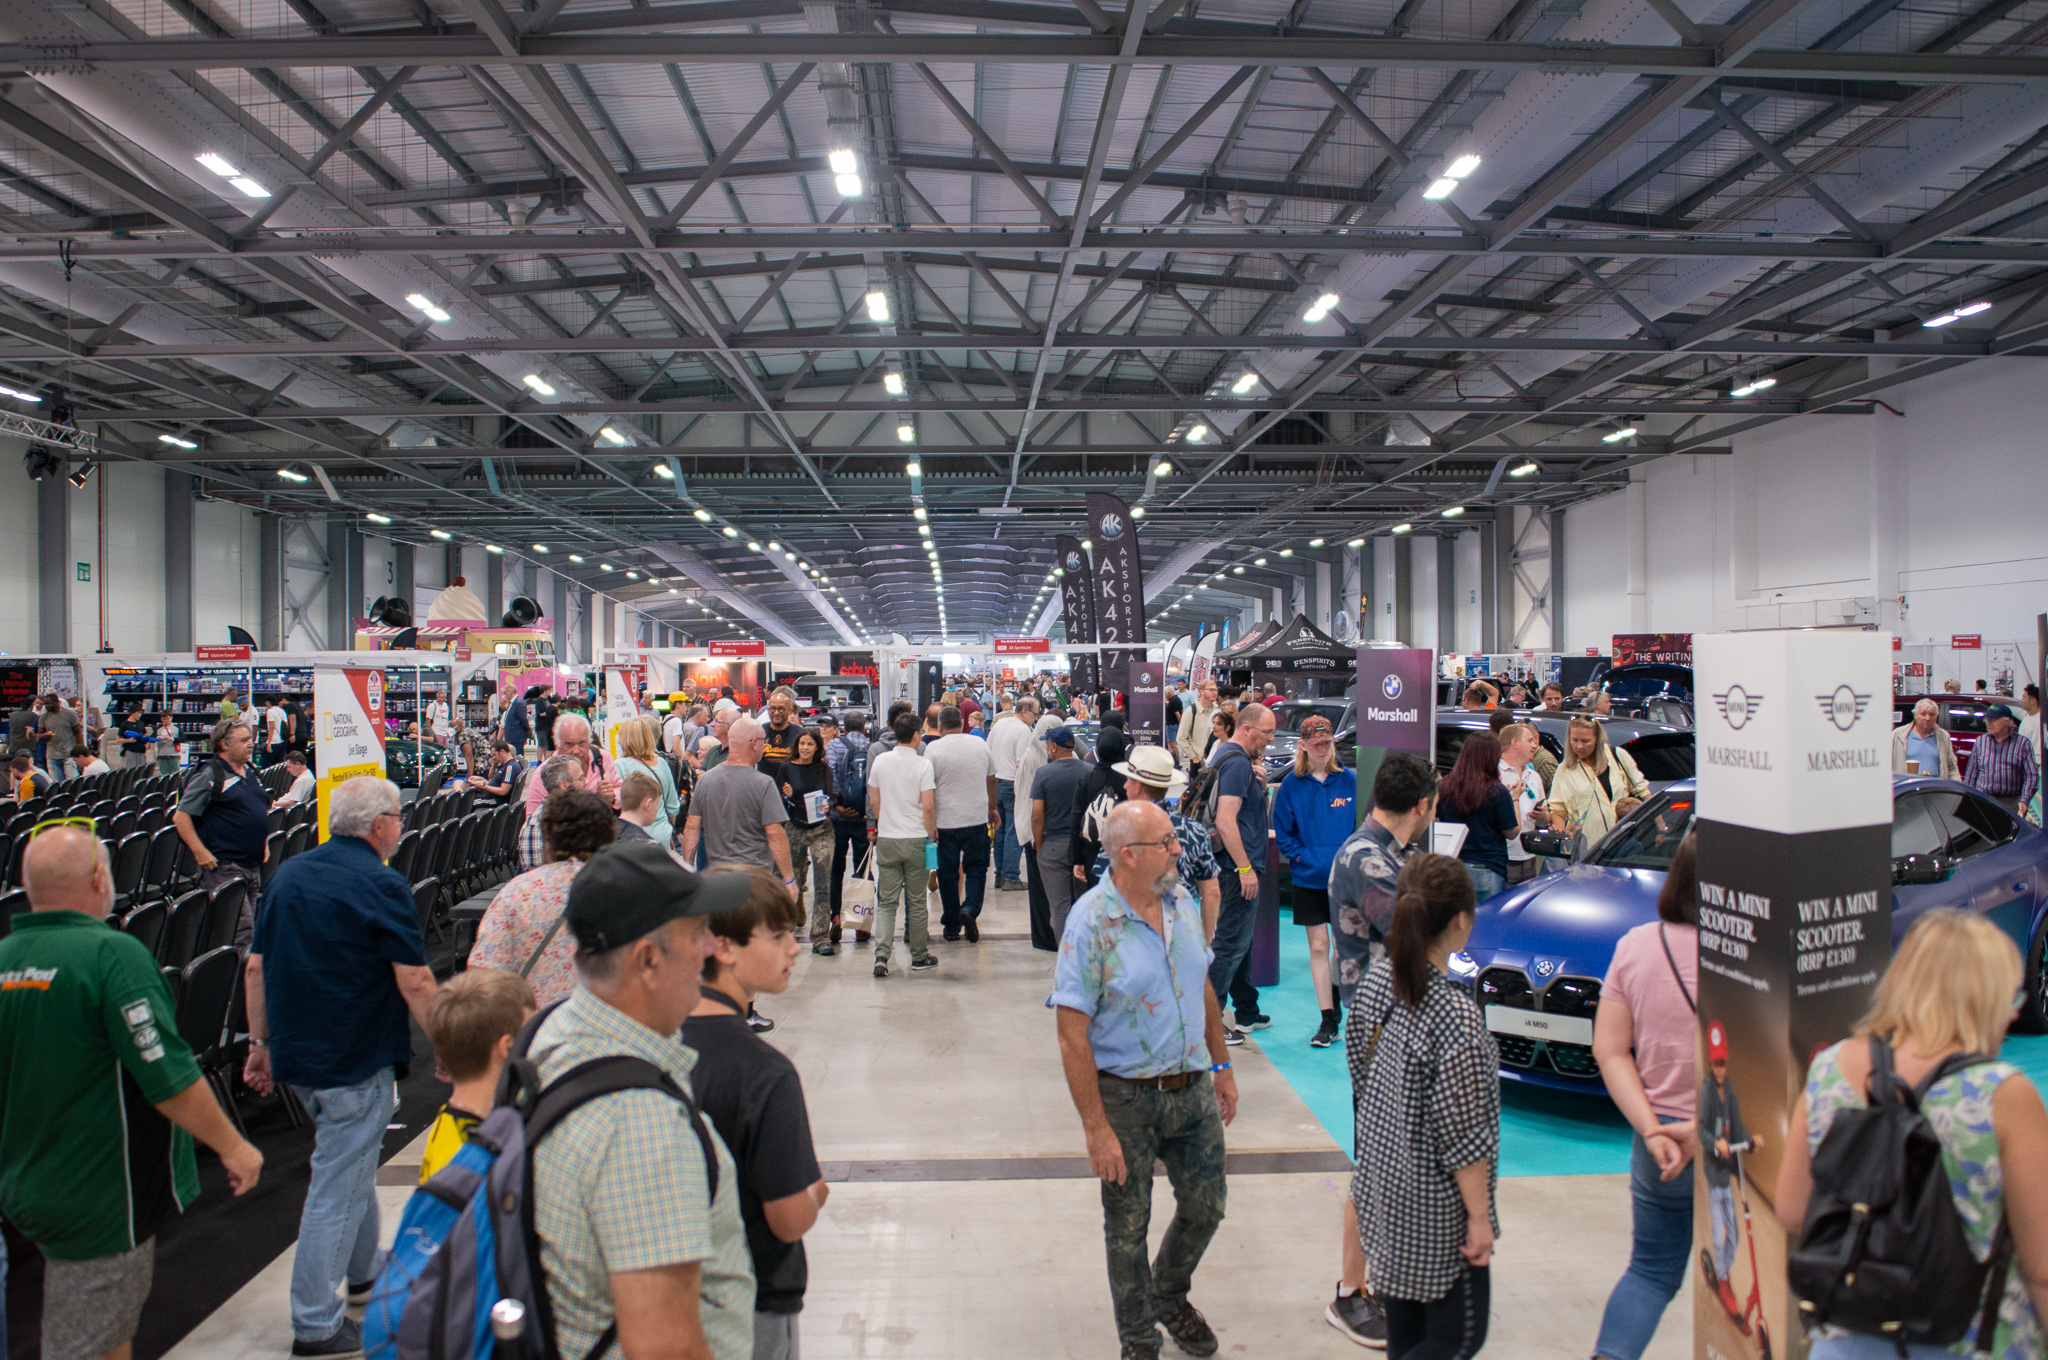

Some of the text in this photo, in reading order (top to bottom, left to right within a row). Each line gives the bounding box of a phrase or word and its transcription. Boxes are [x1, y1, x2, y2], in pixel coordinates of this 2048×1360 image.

[1101, 513, 1121, 535] AK
[387, 561, 393, 584] 3
[1294, 658, 1336, 668] FENSPIRITS
[1634, 652, 1651, 661] THE
[1368, 707, 1418, 722] Marshall
[1727, 702, 1744, 713] MINI
[1834, 701, 1854, 714] MINI
[1707, 746, 1772, 771] MARSHALL
[1807, 748, 1880, 772] MARSHALL
[1699, 881, 1771, 920] WIN A MINI
[1798, 889, 1879, 923] WIN A MINI
[1700, 906, 1758, 943] SCOOTER.
[1797, 919, 1866, 952] SCOOTER.
[1700, 930, 1721, 952] (RRP
[1796, 945, 1858, 974] (RRP £130)
[1532, 1020, 1548, 1029] M50
